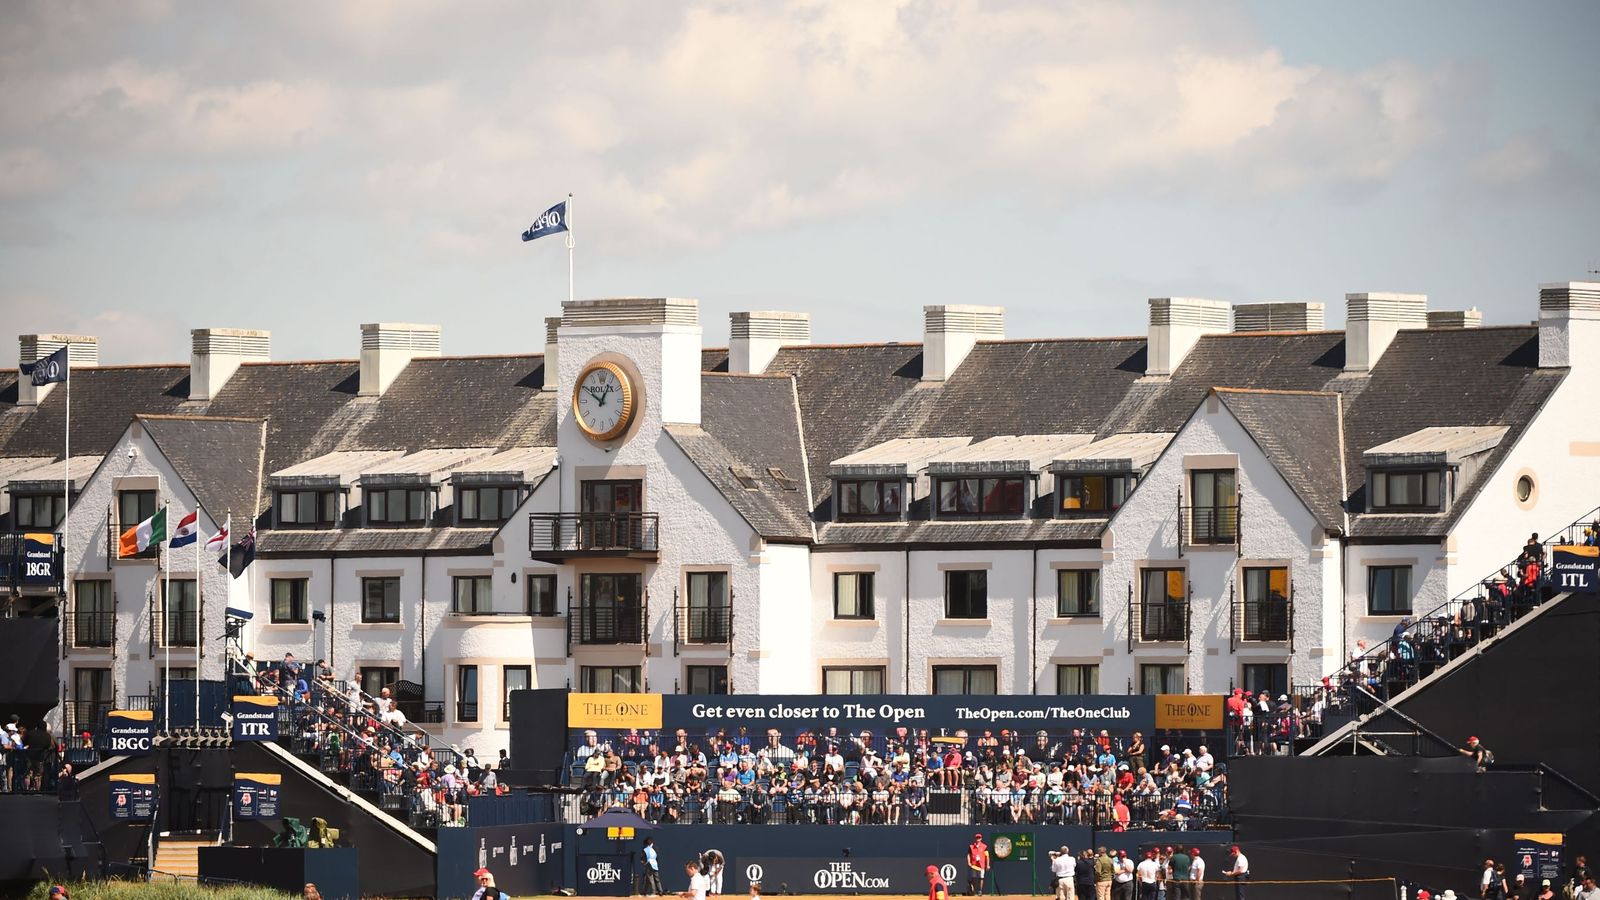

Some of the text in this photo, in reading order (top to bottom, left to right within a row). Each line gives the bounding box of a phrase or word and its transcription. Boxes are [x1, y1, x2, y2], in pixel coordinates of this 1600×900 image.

[26, 562, 51, 576] 18GR
[1555, 562, 1594, 570] Grandstand
[583, 702, 648, 716] THE ONE
[692, 703, 925, 722] Get even closer to The Open
[955, 706, 1131, 722] TheOpen.com/TheOneClub
[1165, 703, 1211, 716] THE ONE
[111, 726, 149, 734] Grandstand
[111, 737, 149, 750] 18GC
[596, 862, 612, 870] THE
[828, 862, 852, 872] THE
[586, 867, 621, 881] OPEN
